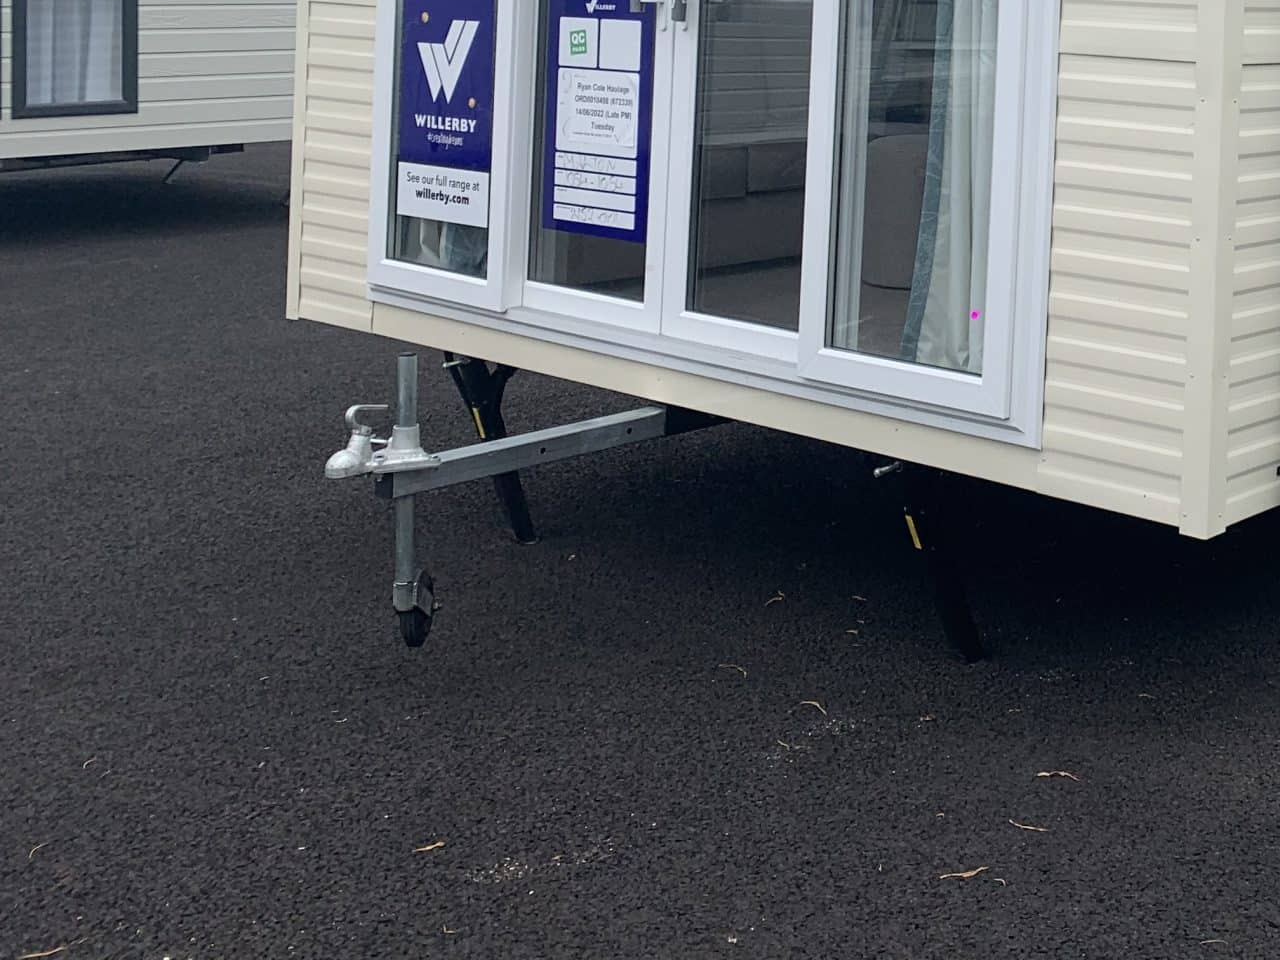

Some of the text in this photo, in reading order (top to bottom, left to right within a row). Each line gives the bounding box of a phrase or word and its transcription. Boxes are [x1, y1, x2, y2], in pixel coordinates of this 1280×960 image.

[571, 32, 585, 45] QC
[577, 82, 591, 91] Ryan
[606, 84, 629, 95] Haulage
[415, 114, 476, 133] WILLERBY
[591, 121, 615, 133] Tuesday
[407, 171, 480, 193] See our full range at
[415, 187, 470, 205] willerby.com
